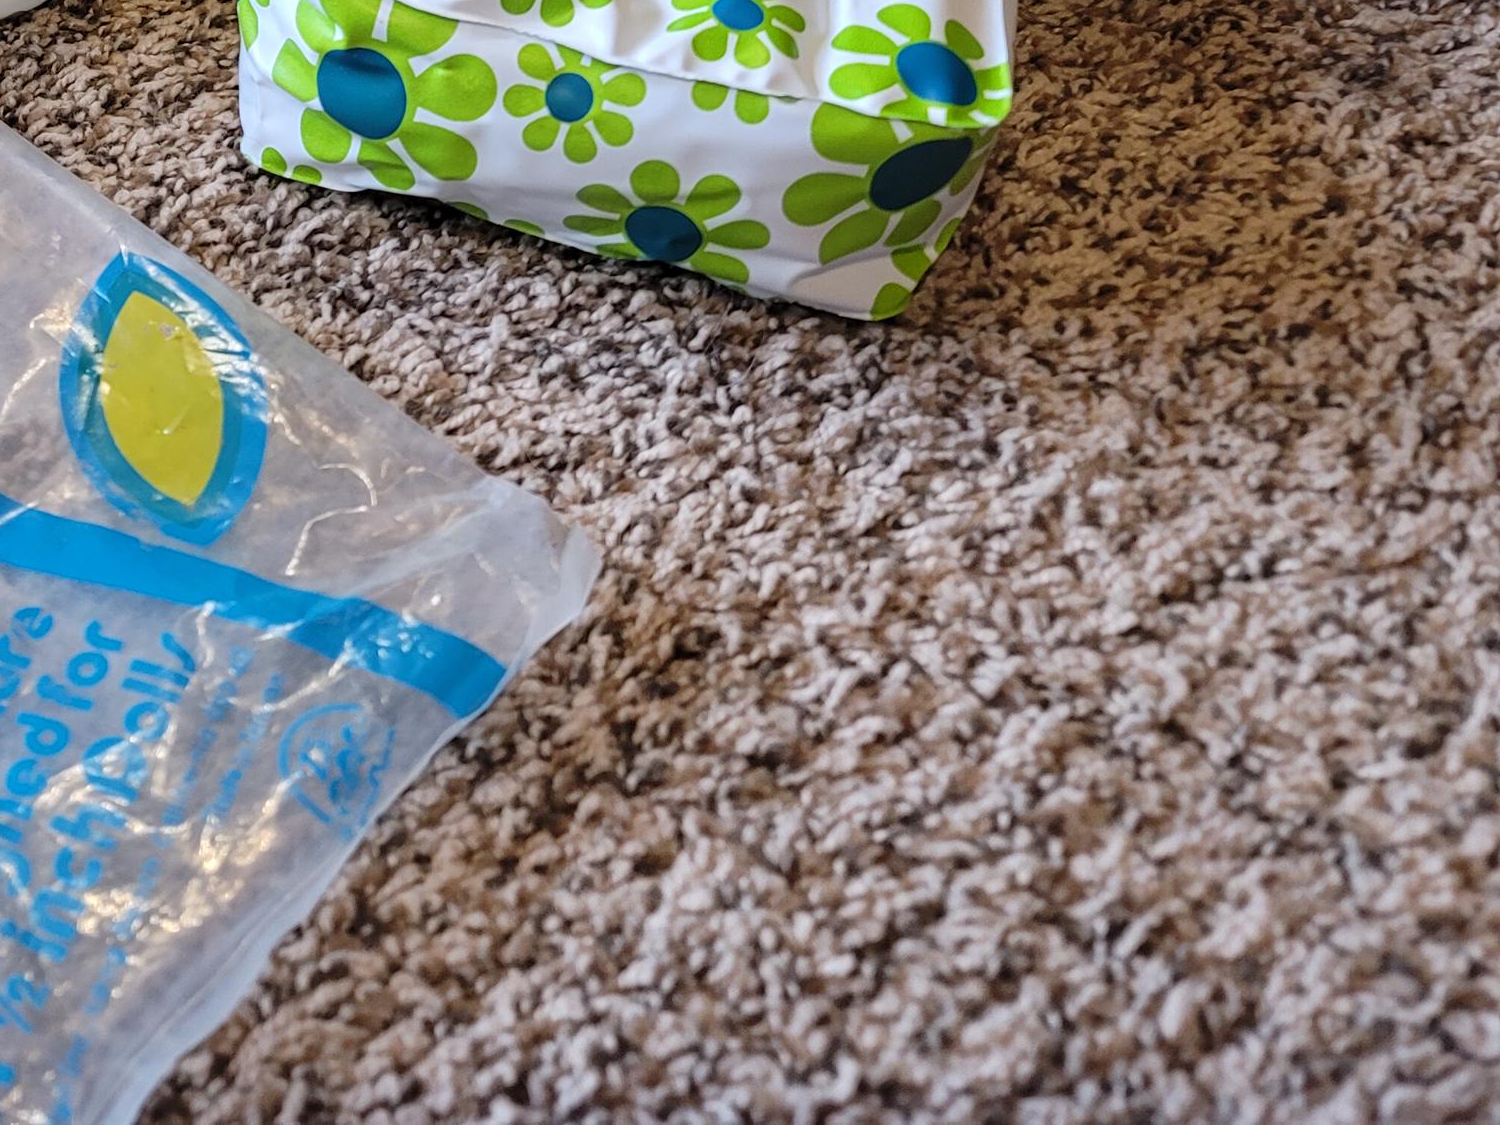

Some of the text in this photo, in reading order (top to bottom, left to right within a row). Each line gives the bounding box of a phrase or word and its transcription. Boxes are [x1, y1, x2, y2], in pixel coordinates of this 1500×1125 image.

[37, 620, 124, 712] for
[0, 805, 128, 963] inch
[83, 632, 197, 803] Dolls
